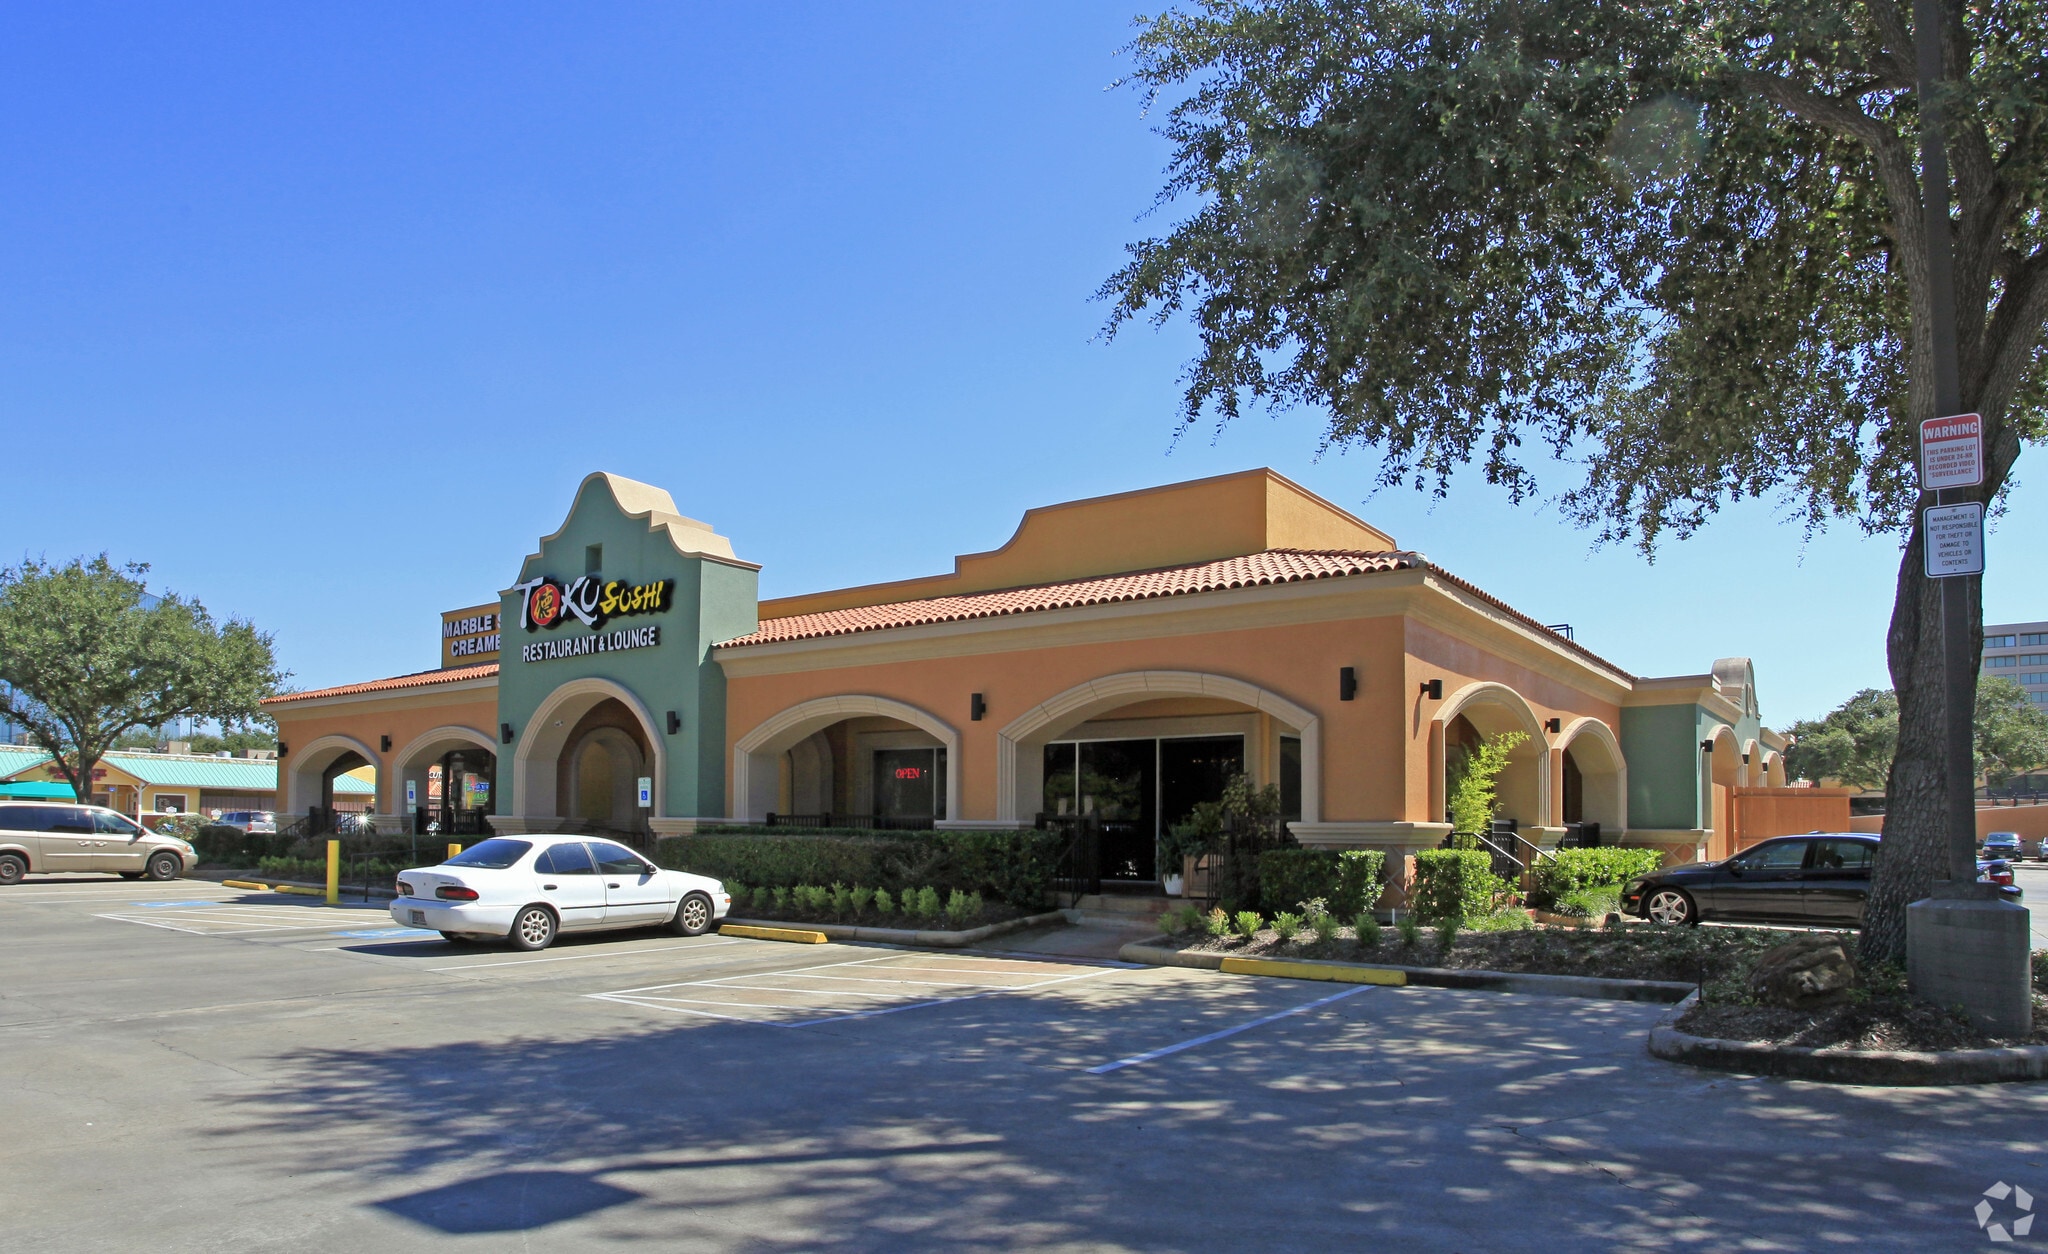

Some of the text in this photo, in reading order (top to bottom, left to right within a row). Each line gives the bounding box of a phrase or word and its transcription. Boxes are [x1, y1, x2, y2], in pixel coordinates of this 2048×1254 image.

[1924, 422, 1977, 439] WARNING
[1940, 446, 1964, 454] PARKING
[1928, 462, 1958, 470] RECORDED
[1942, 522, 1977, 530] RESPONSIBLE
[443, 614, 493, 638] MARBLE
[523, 626, 656, 662] RESTAURANT & LOUNGE
[895, 767, 920, 779] OPEN
